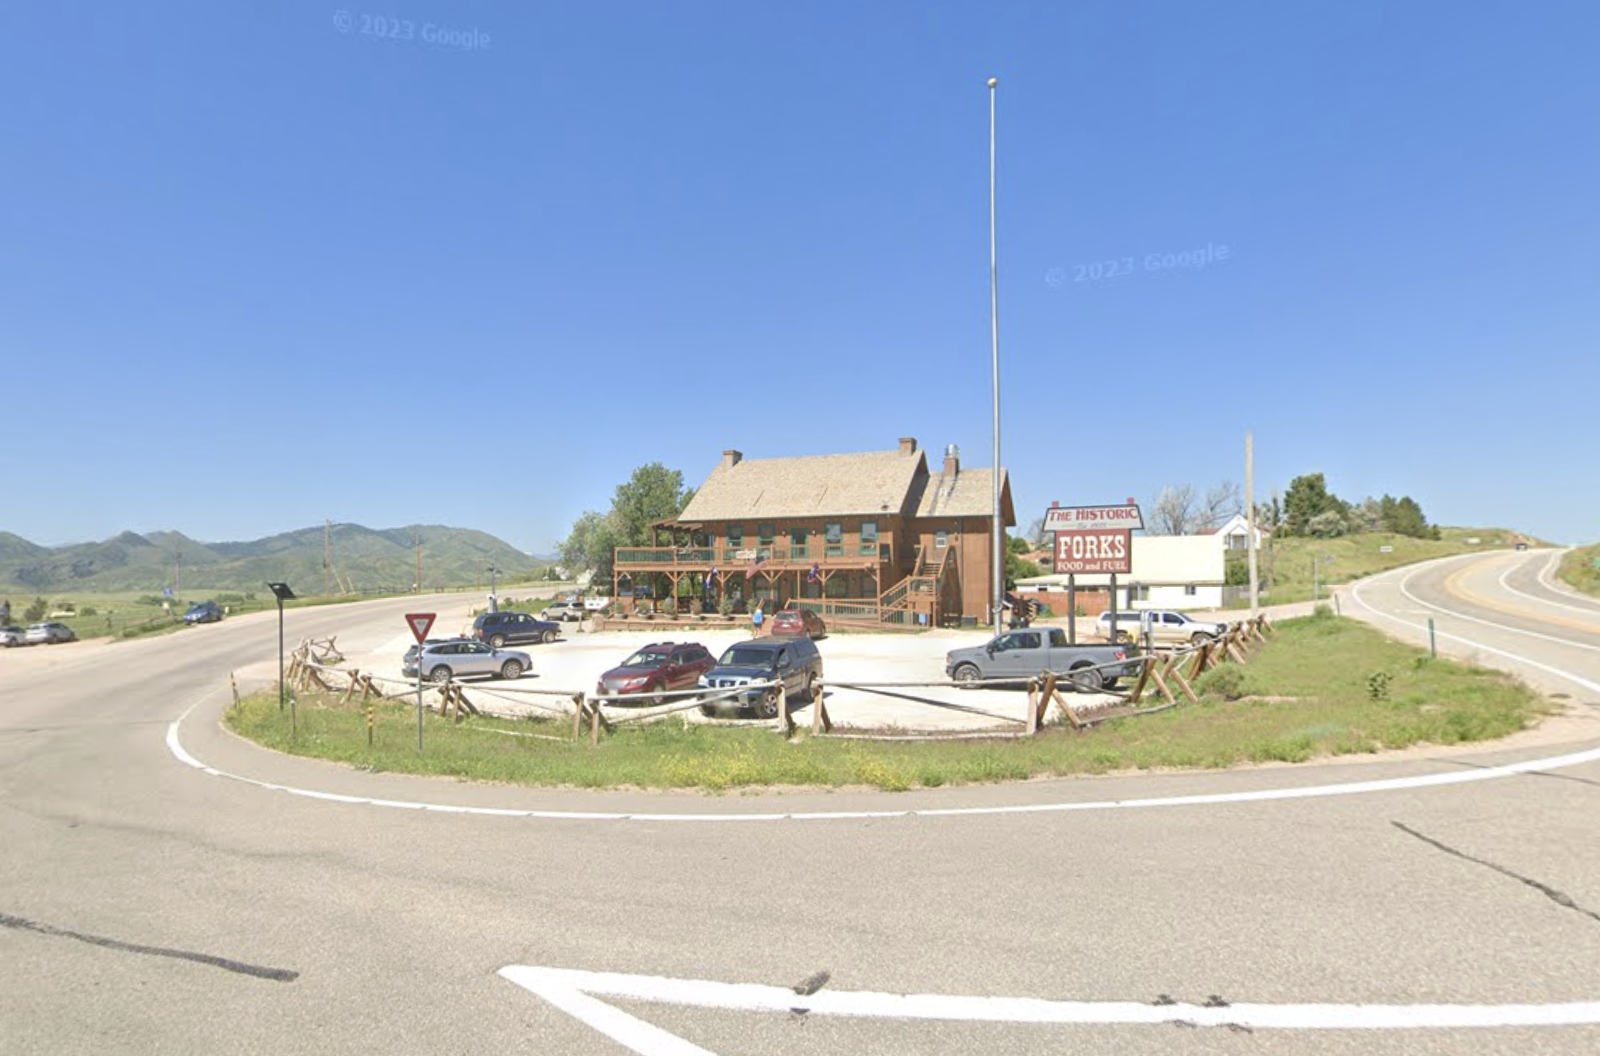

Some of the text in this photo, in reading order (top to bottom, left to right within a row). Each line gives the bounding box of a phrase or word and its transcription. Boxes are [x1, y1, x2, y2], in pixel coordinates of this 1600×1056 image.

[1049, 508, 1138, 522] THE HISTORIC
[1059, 534, 1125, 559] FORKS
[1057, 560, 1127, 571] FOOD and FUEL
